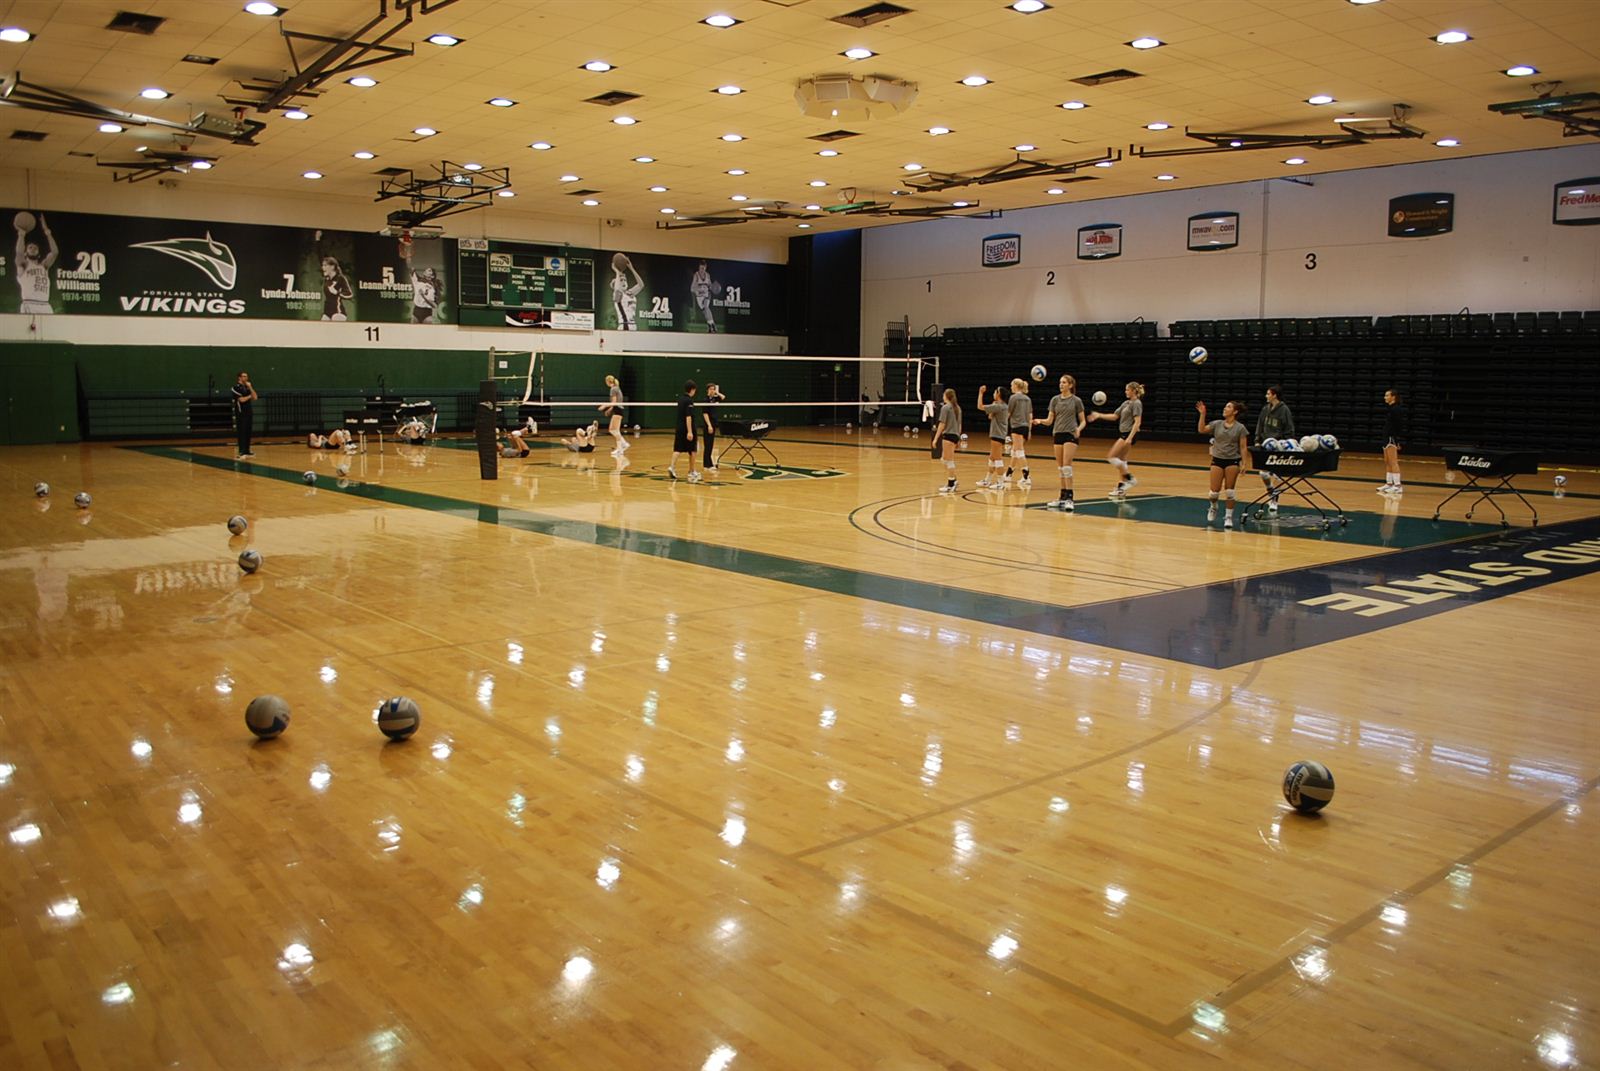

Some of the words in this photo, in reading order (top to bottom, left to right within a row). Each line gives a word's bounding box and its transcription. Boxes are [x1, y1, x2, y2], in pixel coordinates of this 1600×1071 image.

[986, 241, 1016, 255] FREEDOM
[1001, 250, 1016, 260] 970
[77, 252, 106, 275] 20
[1305, 252, 1316, 270] 3
[283, 274, 295, 293] 7
[382, 267, 395, 285] 5
[1046, 271, 1056, 285] 2
[57, 280, 100, 291] Williams
[926, 280, 931, 293] 1
[261, 289, 286, 299] Lynda
[726, 286, 740, 301] 31
[120, 296, 246, 314] VIKINGS
[652, 296, 669, 313] 24
[364, 326, 380, 341] 11
[1297, 561, 1552, 617] STATE
